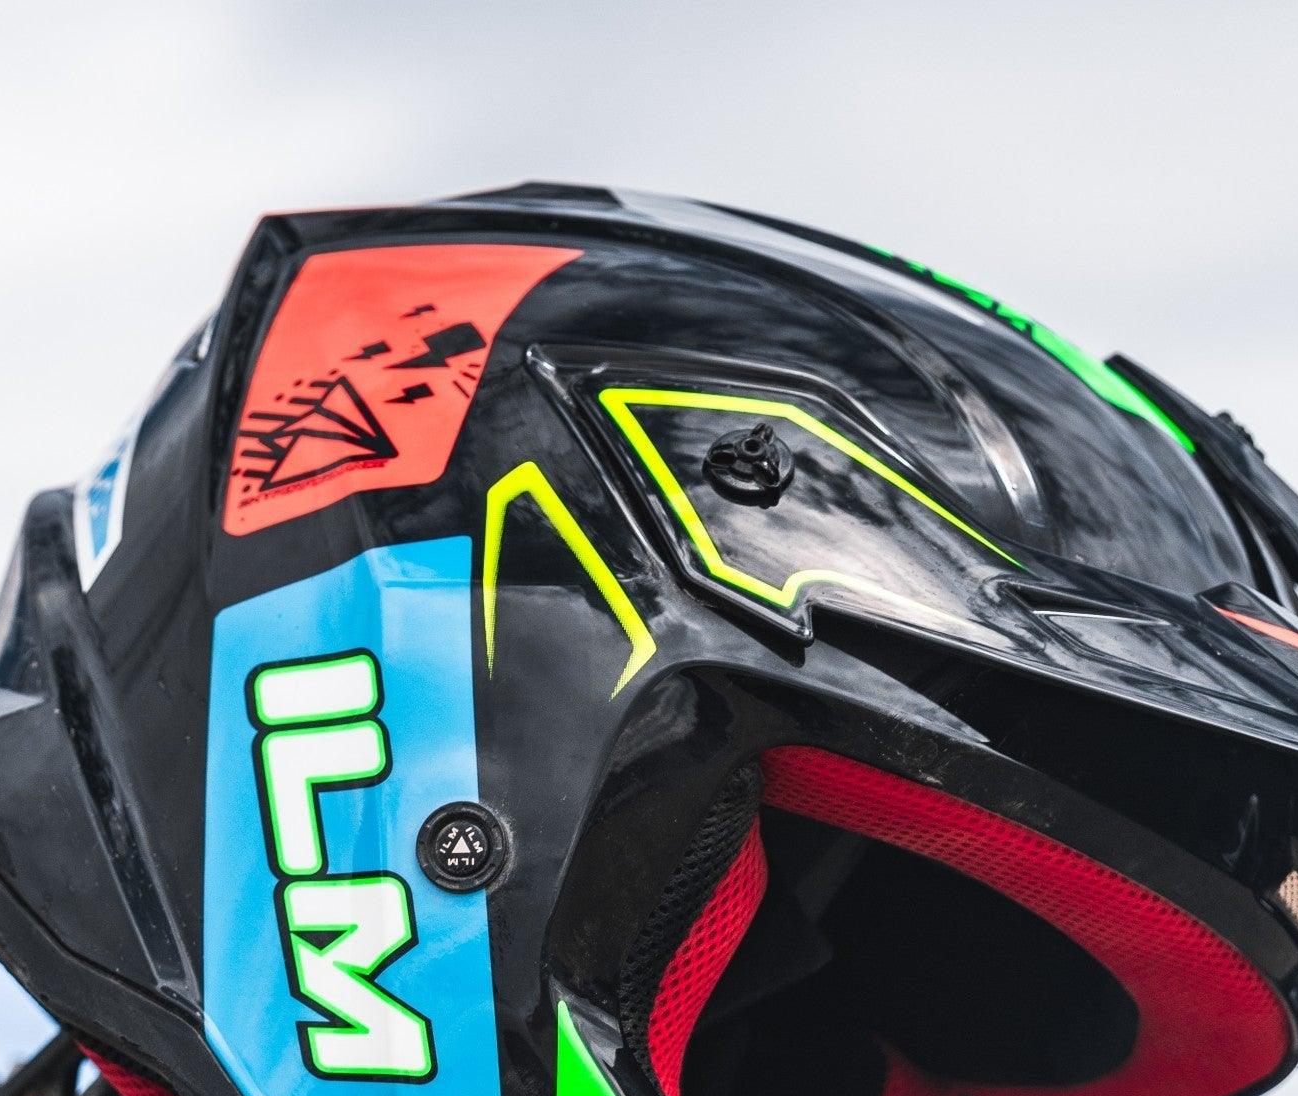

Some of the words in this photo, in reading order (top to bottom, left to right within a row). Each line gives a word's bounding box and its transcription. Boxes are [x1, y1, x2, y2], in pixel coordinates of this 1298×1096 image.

[439, 826, 460, 854] ILM
[465, 826, 484, 854] ILM
[250, 652, 434, 1079] ILM
[447, 857, 475, 866] ILM
